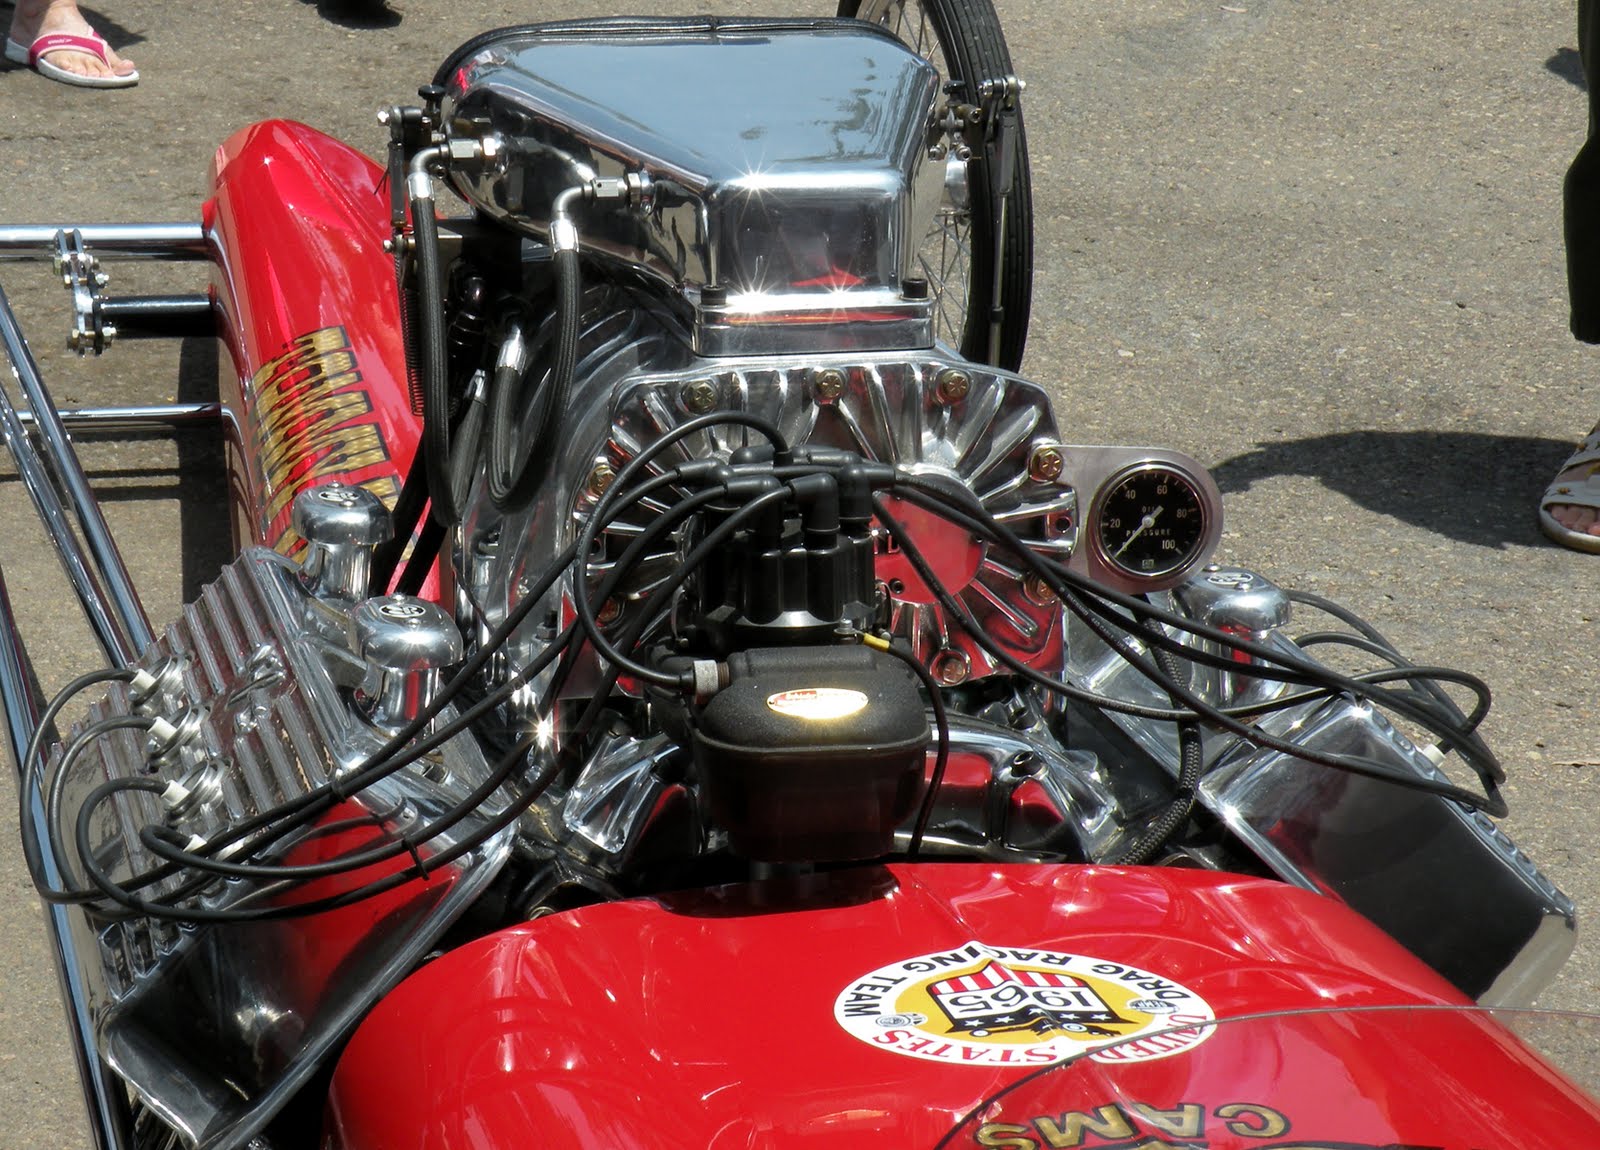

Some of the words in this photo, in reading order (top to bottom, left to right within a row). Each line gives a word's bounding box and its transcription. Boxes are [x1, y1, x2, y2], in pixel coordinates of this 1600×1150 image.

[1125, 490, 1136, 500] 40
[1156, 485, 1168, 495] 60
[1110, 518, 1121, 528] 20
[1177, 508, 1187, 518] 80
[1126, 528, 1171, 537] PSSURE
[1162, 539, 1176, 549] 100
[1064, 593, 1090, 616] PACKARD
[903, 945, 1072, 972] RACING
[1092, 964, 1190, 999] DRAG
[844, 976, 908, 1017] TEAM
[949, 985, 1093, 1013] 1965
[872, 1029, 1058, 1062] STATES
[1086, 1014, 1207, 1059] UNITED
[974, 1102, 1291, 1150] CAMS
